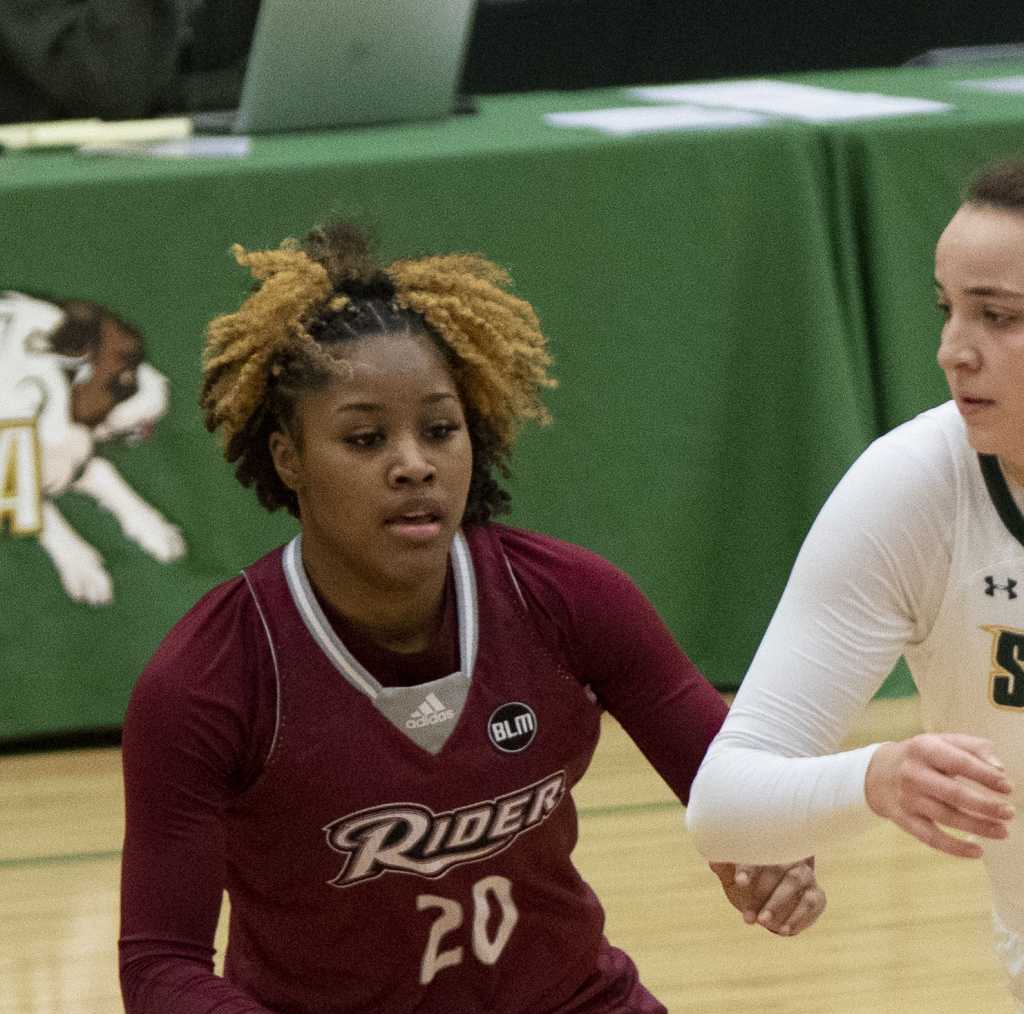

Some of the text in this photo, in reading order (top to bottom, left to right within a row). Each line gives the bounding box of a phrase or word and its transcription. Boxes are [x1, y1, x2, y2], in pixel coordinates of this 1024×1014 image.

[405, 708, 455, 729] adidas
[323, 769, 567, 888] RIDER
[415, 874, 519, 985] 20
